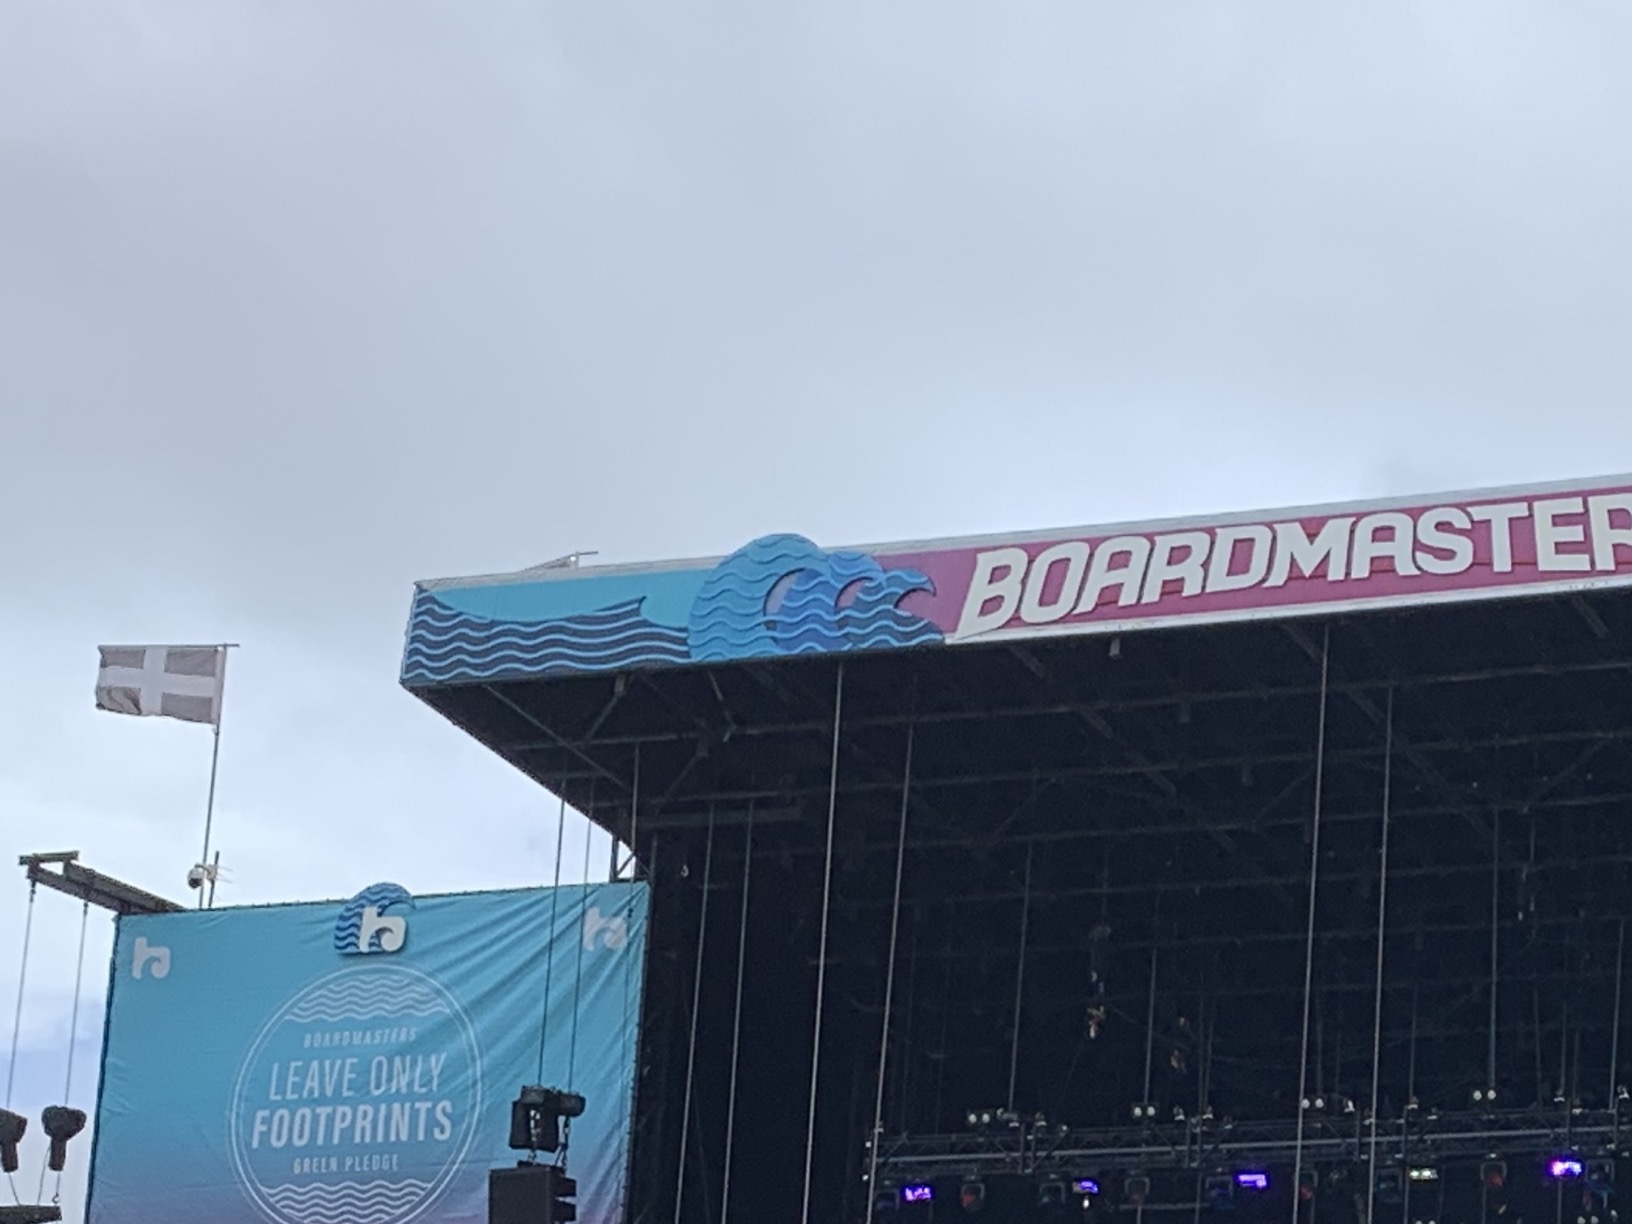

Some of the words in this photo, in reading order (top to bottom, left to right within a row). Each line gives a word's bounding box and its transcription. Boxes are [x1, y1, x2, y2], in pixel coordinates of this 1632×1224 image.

[269, 1058, 358, 1101] LEAVE
[370, 1053, 448, 1095] ONLY
[251, 1100, 454, 1150] FOOTPRINTS
[344, 1153, 400, 1173] PLEDGE
